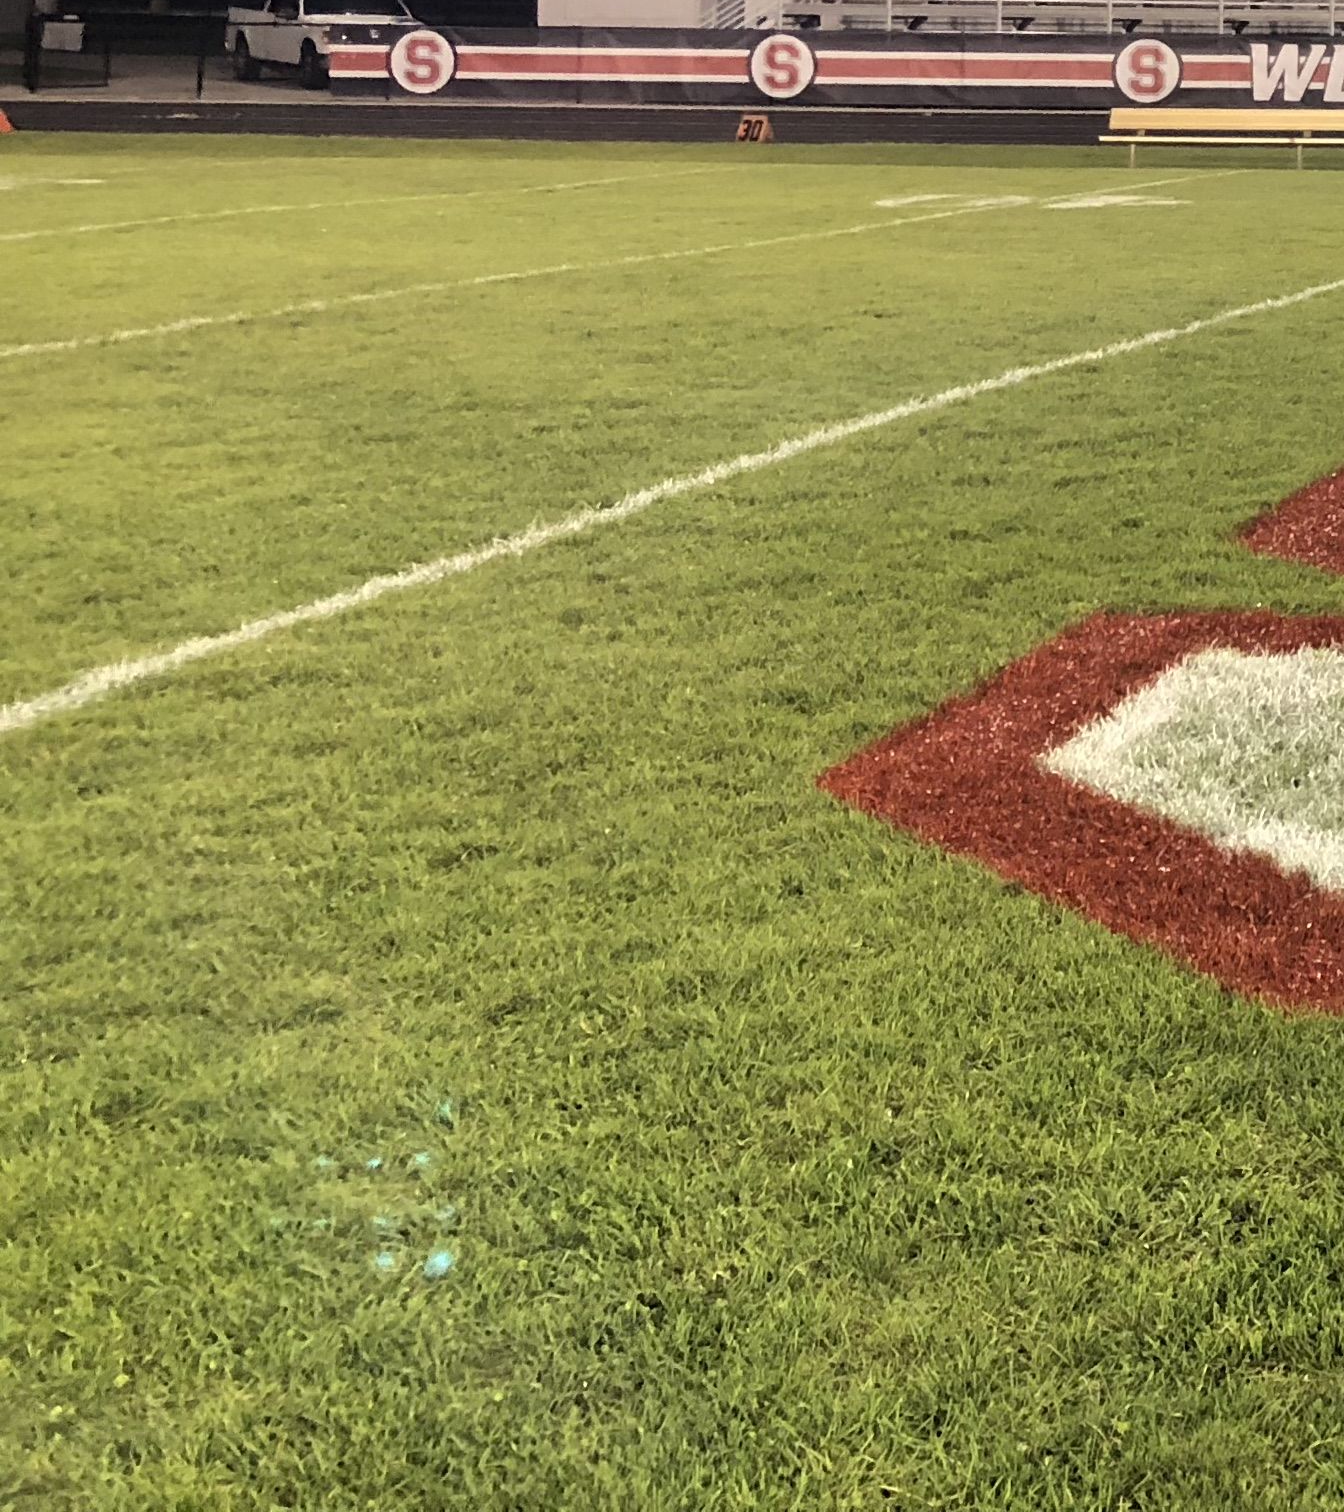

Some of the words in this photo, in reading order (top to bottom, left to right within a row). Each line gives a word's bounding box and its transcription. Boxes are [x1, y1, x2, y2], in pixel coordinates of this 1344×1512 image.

[403, 39, 441, 85] S
[761, 43, 801, 90] S
[1127, 45, 1167, 95] S
[738, 119, 764, 142] 30
